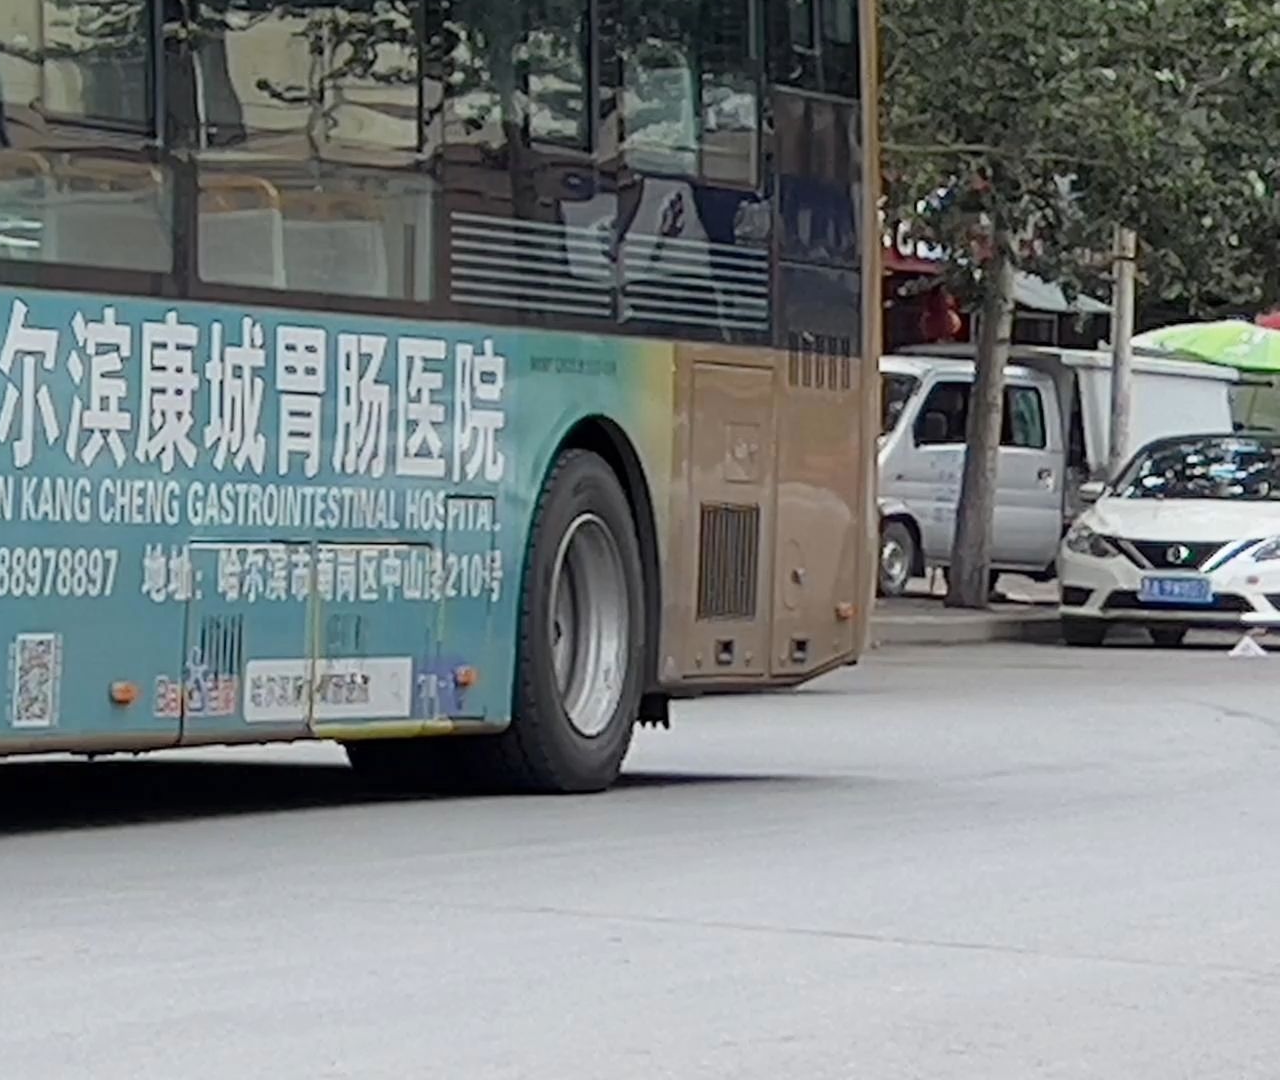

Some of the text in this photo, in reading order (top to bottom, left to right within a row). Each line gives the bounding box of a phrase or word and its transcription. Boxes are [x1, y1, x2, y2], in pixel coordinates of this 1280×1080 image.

[20, 475, 92, 522] KANG
[98, 478, 181, 525] CHENG
[187, 481, 400, 531] GASTROINTESTINAL
